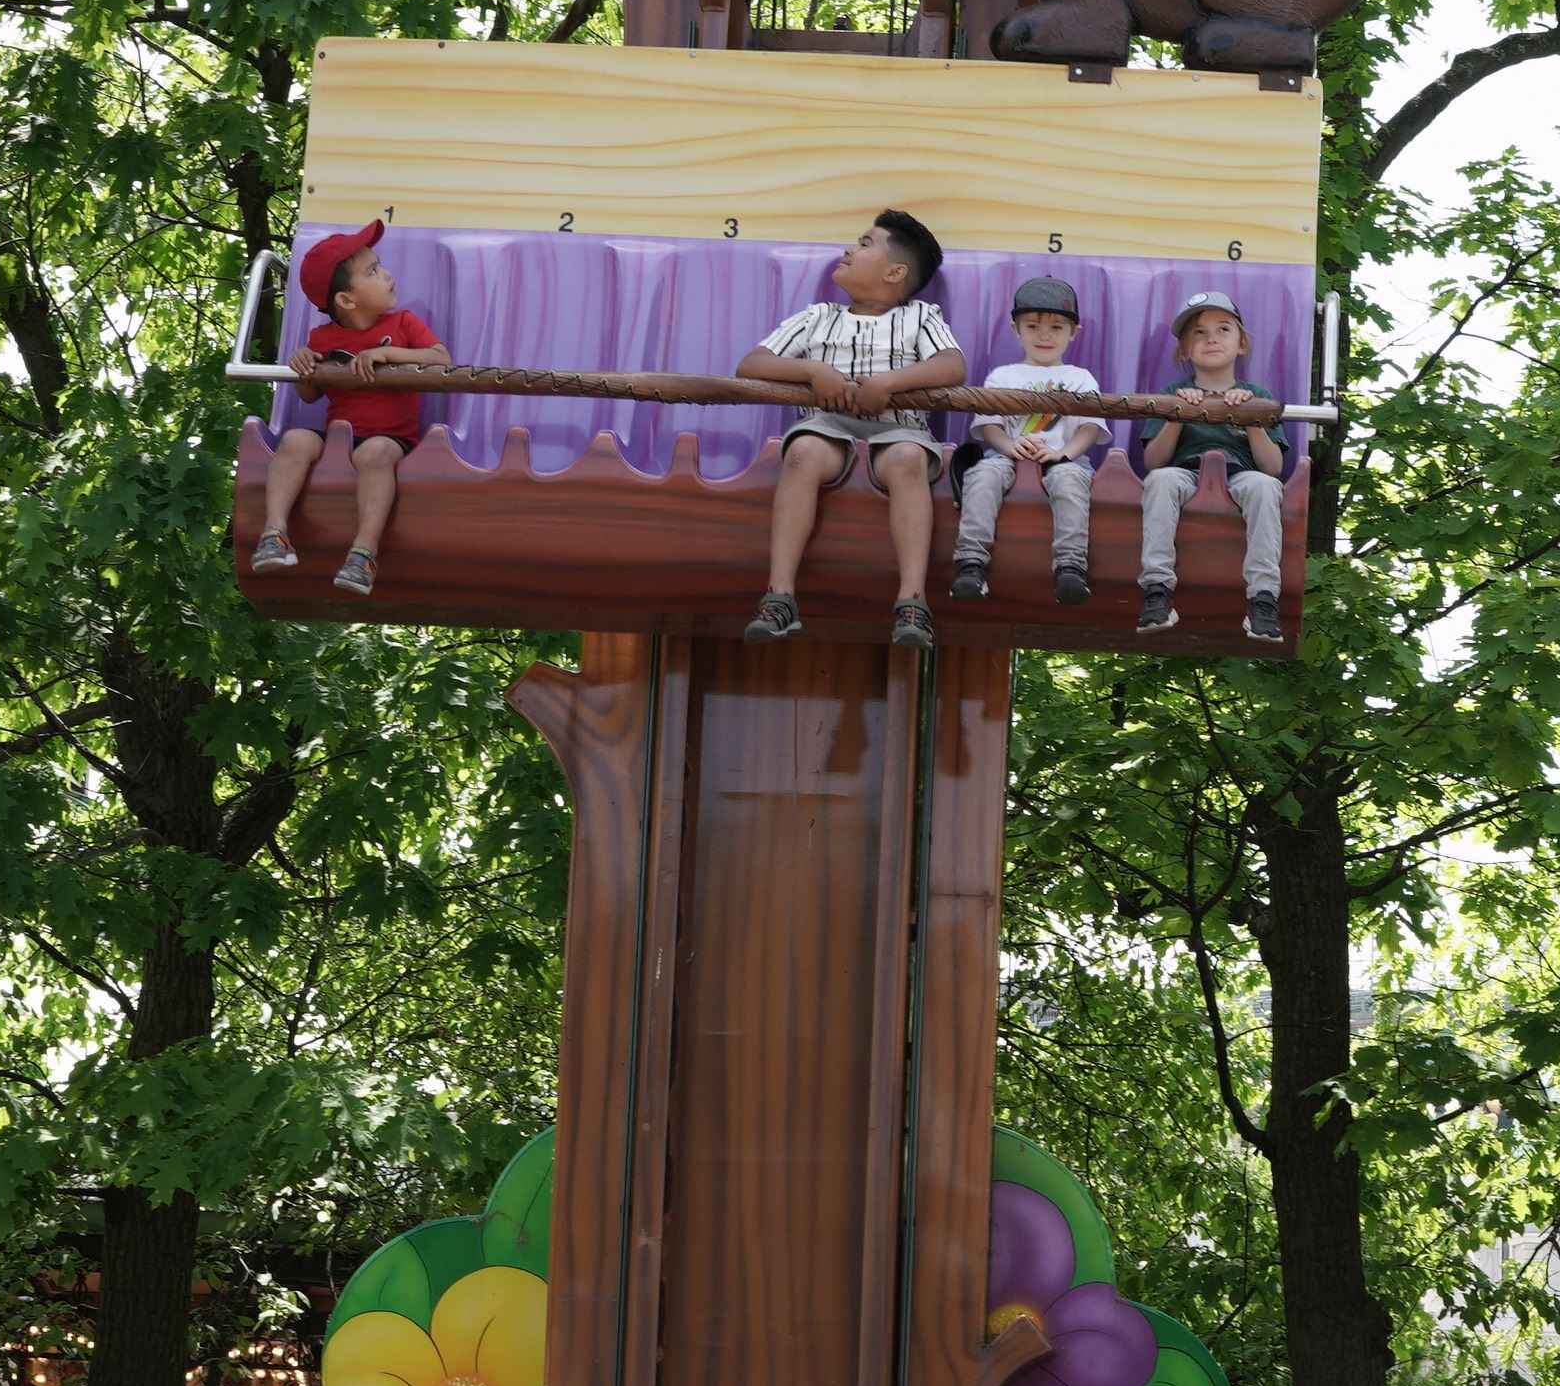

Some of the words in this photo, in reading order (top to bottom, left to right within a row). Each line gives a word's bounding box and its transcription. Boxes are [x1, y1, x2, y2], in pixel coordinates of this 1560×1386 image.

[384, 206, 394, 223] 1
[558, 213, 575, 232] 2
[723, 218, 739, 238] 3
[1048, 233, 1063, 253] 5
[1227, 241, 1243, 261] 6
